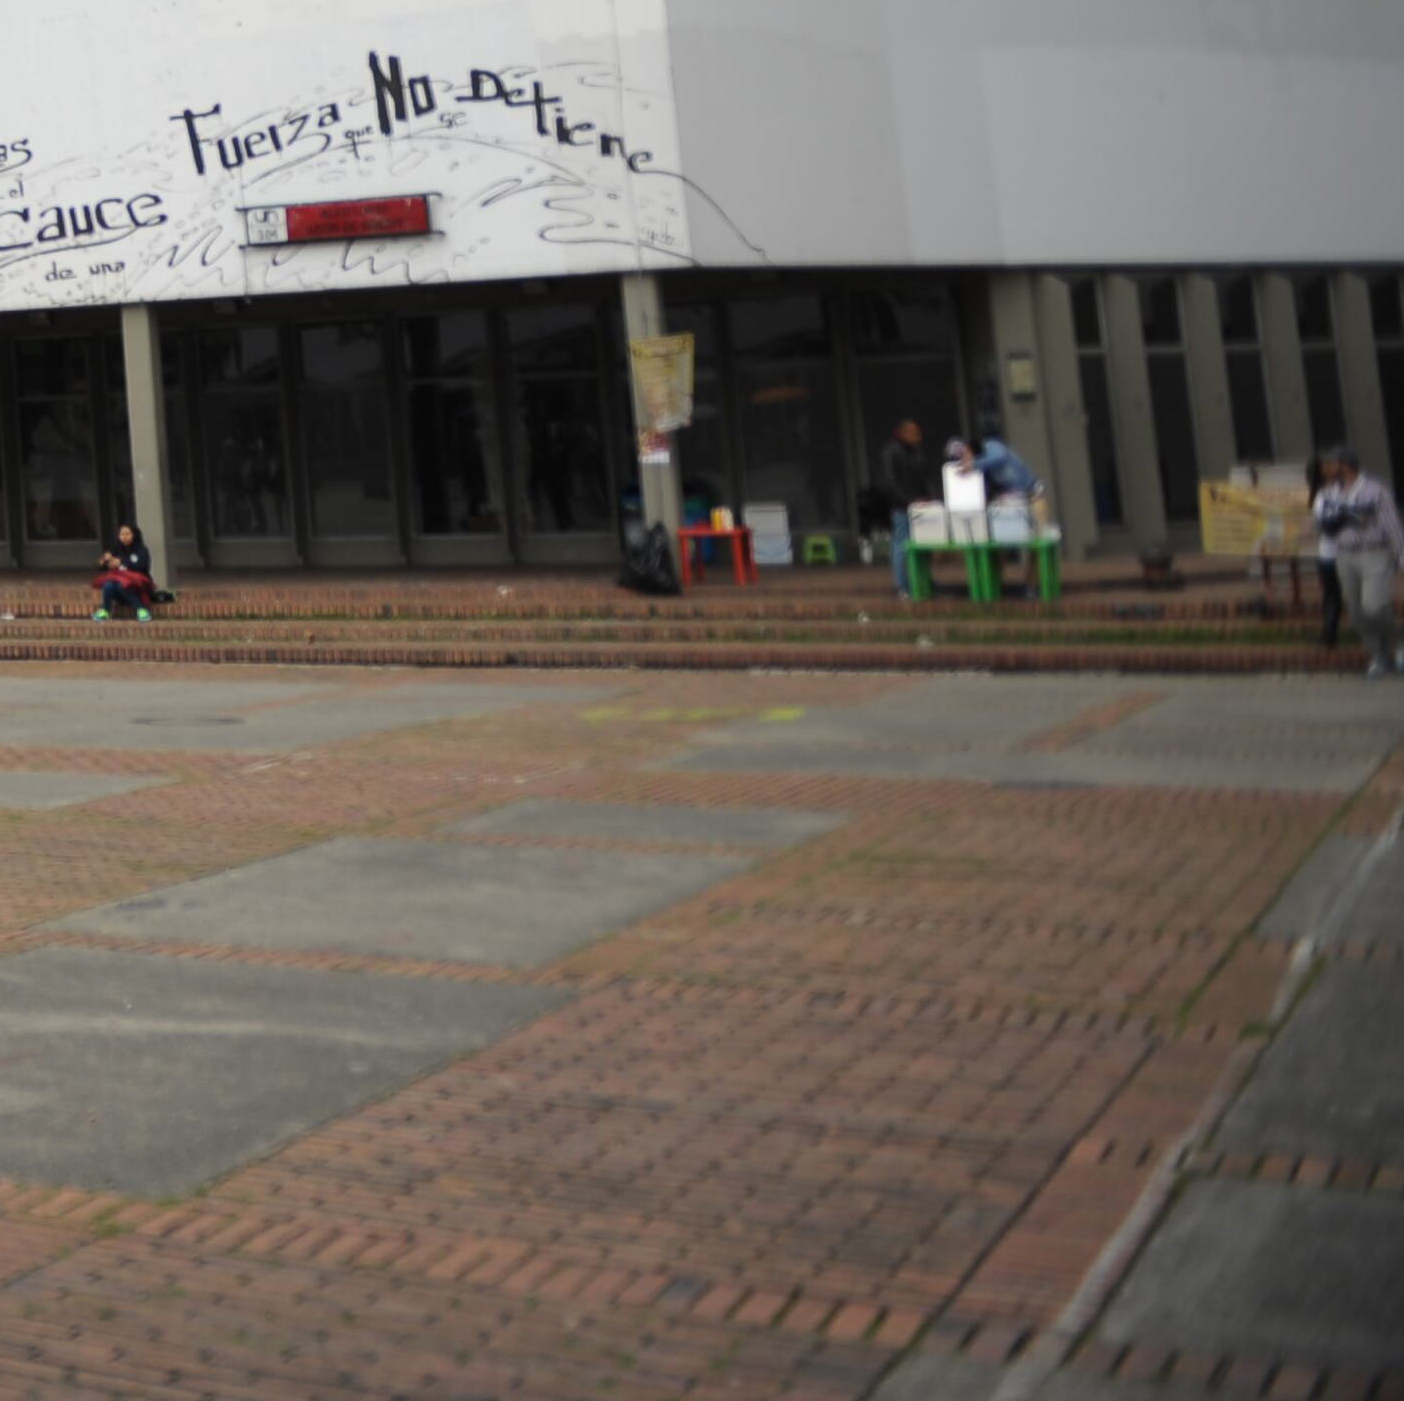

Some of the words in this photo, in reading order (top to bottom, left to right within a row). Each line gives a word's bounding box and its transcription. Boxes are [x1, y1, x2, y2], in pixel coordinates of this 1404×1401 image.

[169, 103, 343, 176] Fuerza
[343, 125, 374, 159] que
[438, 110, 469, 130] se
[455, 67, 654, 176] Detiene
[9, 180, 25, 200] el
[45, 261, 75, 283] de
[88, 259, 127, 278] una
